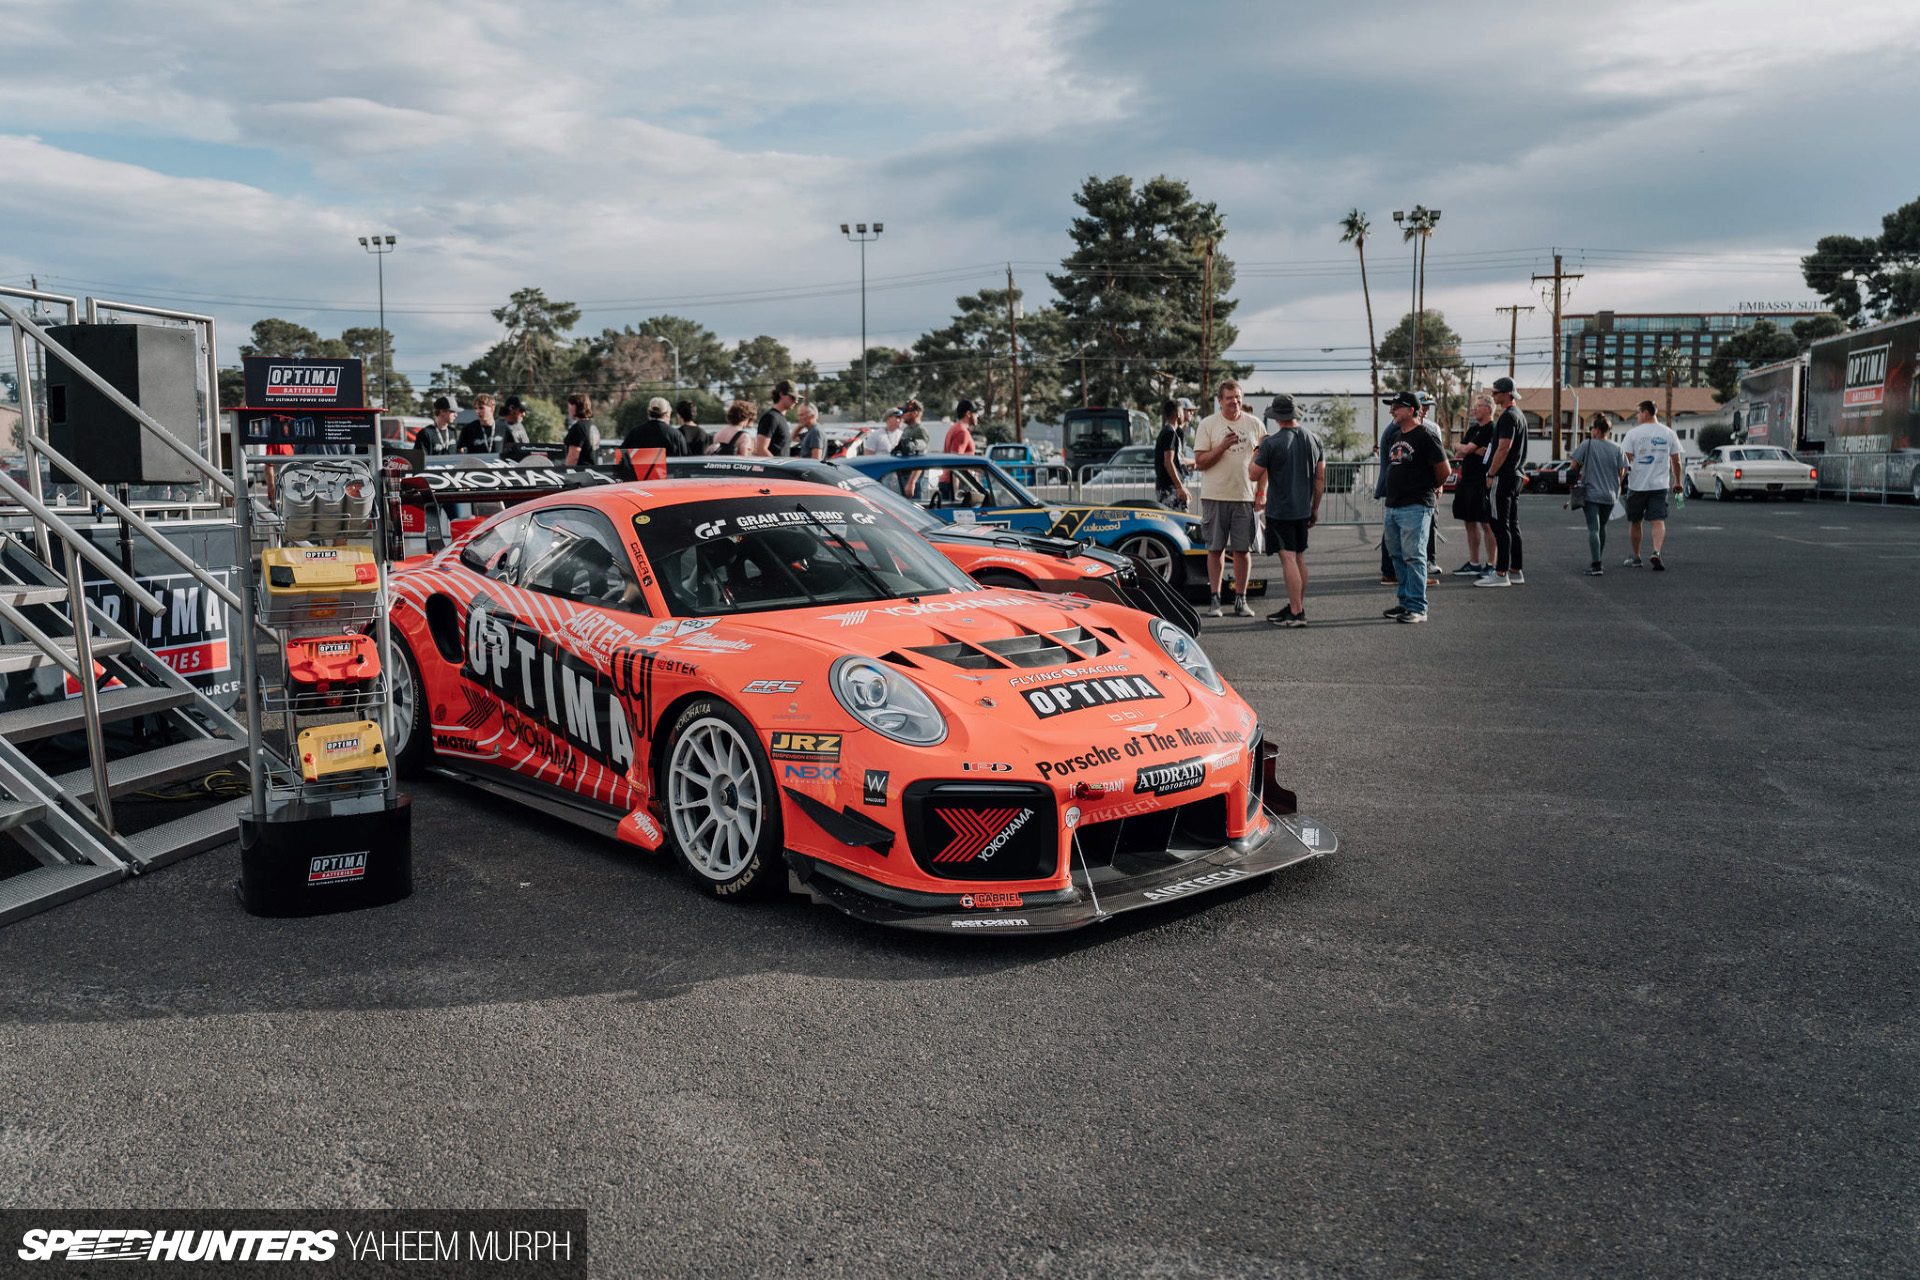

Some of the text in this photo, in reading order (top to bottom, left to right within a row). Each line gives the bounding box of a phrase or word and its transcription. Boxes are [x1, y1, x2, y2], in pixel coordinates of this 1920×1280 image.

[1738, 301, 1793, 310] EMBASSY
[271, 369, 336, 384] OPTIMA
[1847, 352, 1885, 385] OPTIMA
[703, 462, 752, 471] James Clay
[736, 511, 843, 527] GRAN TURSMO
[778, 519, 807, 528] DRIVING
[73, 586, 222, 640] PIMA
[872, 597, 1037, 616] YOKOHAMA
[562, 608, 638, 655] AIRTEC
[679, 630, 756, 650] Milwaukee
[319, 644, 350, 652] OPTIMA
[666, 660, 700, 676] STEK
[1009, 664, 1128, 687] FLYING RACING
[198, 681, 239, 697] OURCE
[468, 606, 634, 769] OPTIMA
[611, 646, 659, 742] 991
[742, 680, 803, 693] PFC
[1029, 677, 1159, 714] OPTIMA
[675, 703, 711, 731] YOKOHAMA
[1107, 708, 1145, 722] bbi
[327, 740, 359, 750] OPTIMA
[436, 735, 480, 752] MOTUL
[499, 705, 577, 781] YOKOHAMA
[773, 734, 841, 752] JRZ
[772, 752, 805, 760] SUSPENSION
[1035, 726, 1245, 781] Porsche of The Main Line
[785, 765, 842, 780] NEXX
[962, 762, 1013, 772] IPD
[1137, 762, 1205, 789] AUDRAIN
[866, 774, 886, 793] W
[1158, 777, 1203, 793] MOTORSPORT
[632, 811, 659, 842] rotiform
[977, 807, 1035, 862] YOKOHAMA
[312, 854, 364, 872] OPTIMA
[322, 870, 354, 878] BATTERIES
[715, 853, 760, 895] ADVAN
[1143, 868, 1249, 900] AIRTECH
[978, 893, 1021, 903] GABRIEL
